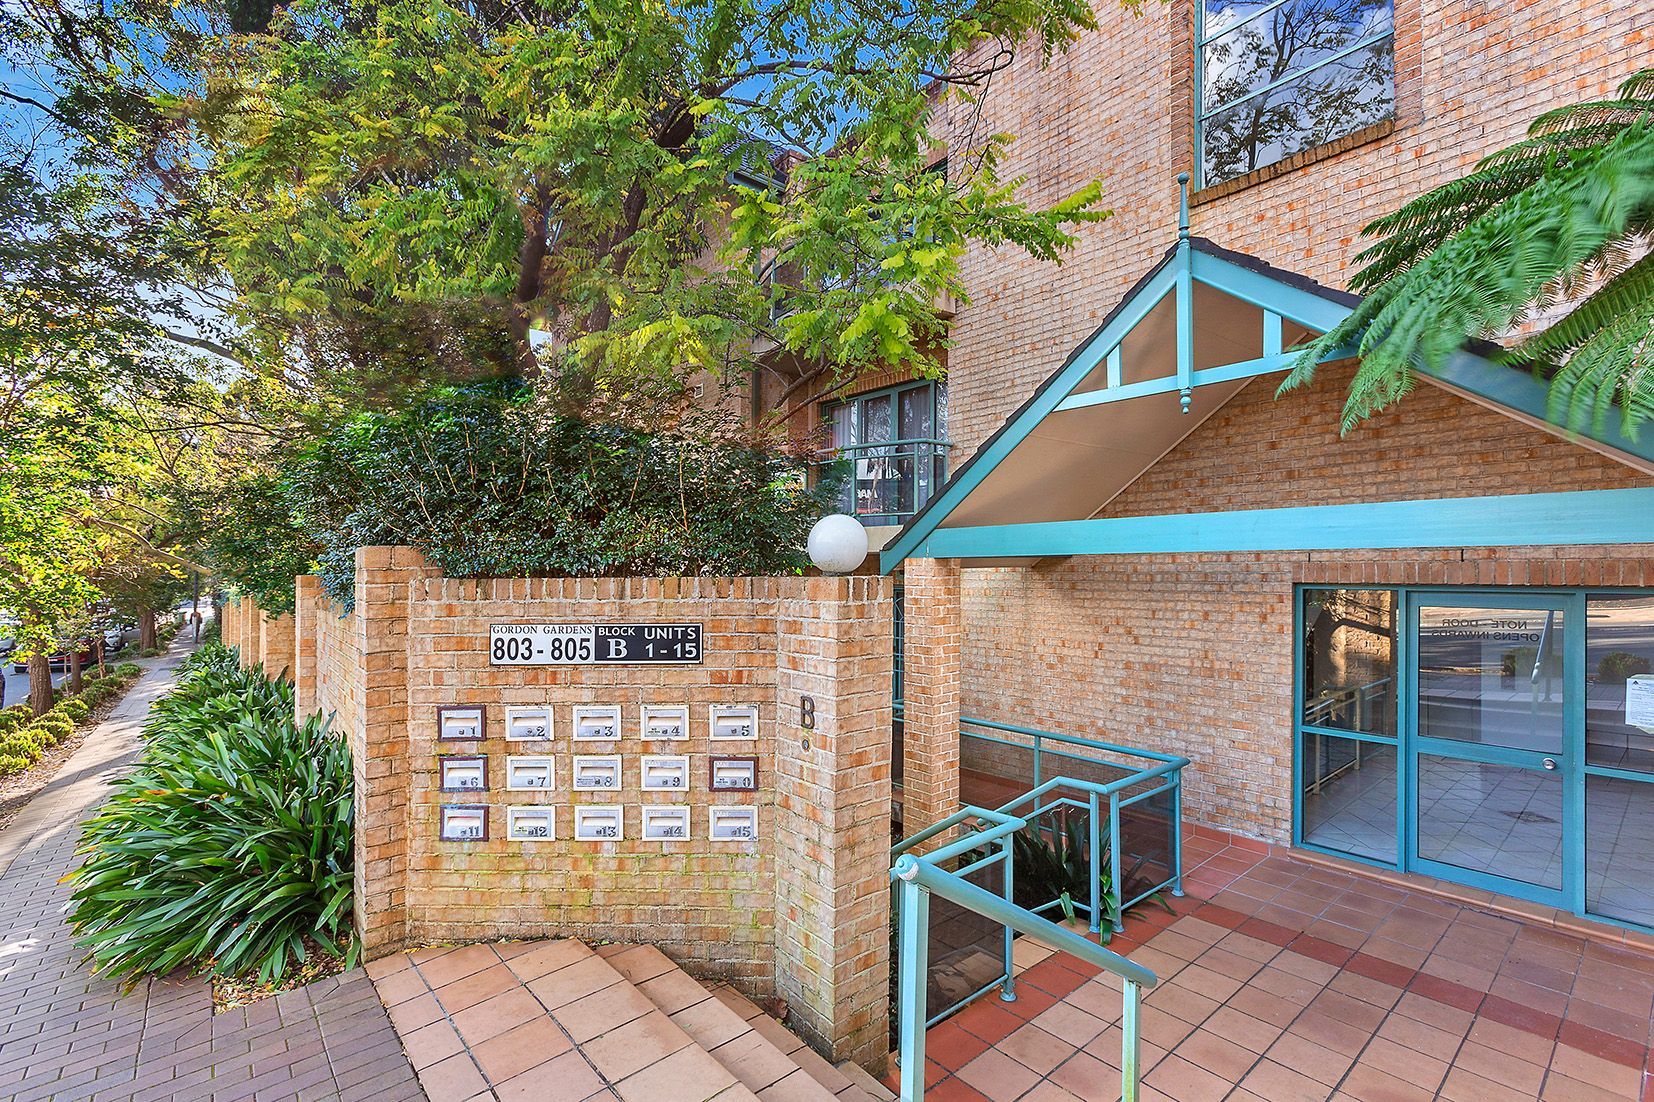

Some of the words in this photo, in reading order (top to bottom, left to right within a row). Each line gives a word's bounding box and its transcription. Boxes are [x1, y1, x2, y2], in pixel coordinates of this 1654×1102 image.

[492, 625, 538, 634] GORDON
[542, 625, 592, 634] GARDENS
[598, 627, 635, 636] BLOCK
[644, 627, 696, 640] UNITS
[493, 637, 533, 661] 803
[550, 637, 591, 661] 805
[606, 638, 628, 659] B
[645, 643, 654, 658] 1
[673, 643, 697, 658] 15
[800, 695, 815, 730] B
[536, 726, 545, 737] 2
[604, 726, 614, 737] 3
[671, 726, 681, 737] 4
[741, 725, 750, 737] 5
[470, 776, 479, 787] 6
[537, 776, 546, 787] 7
[604, 776, 613, 788] 8
[672, 776, 681, 788] 9
[602, 826, 617, 838] 13
[737, 826, 751, 838] 15
